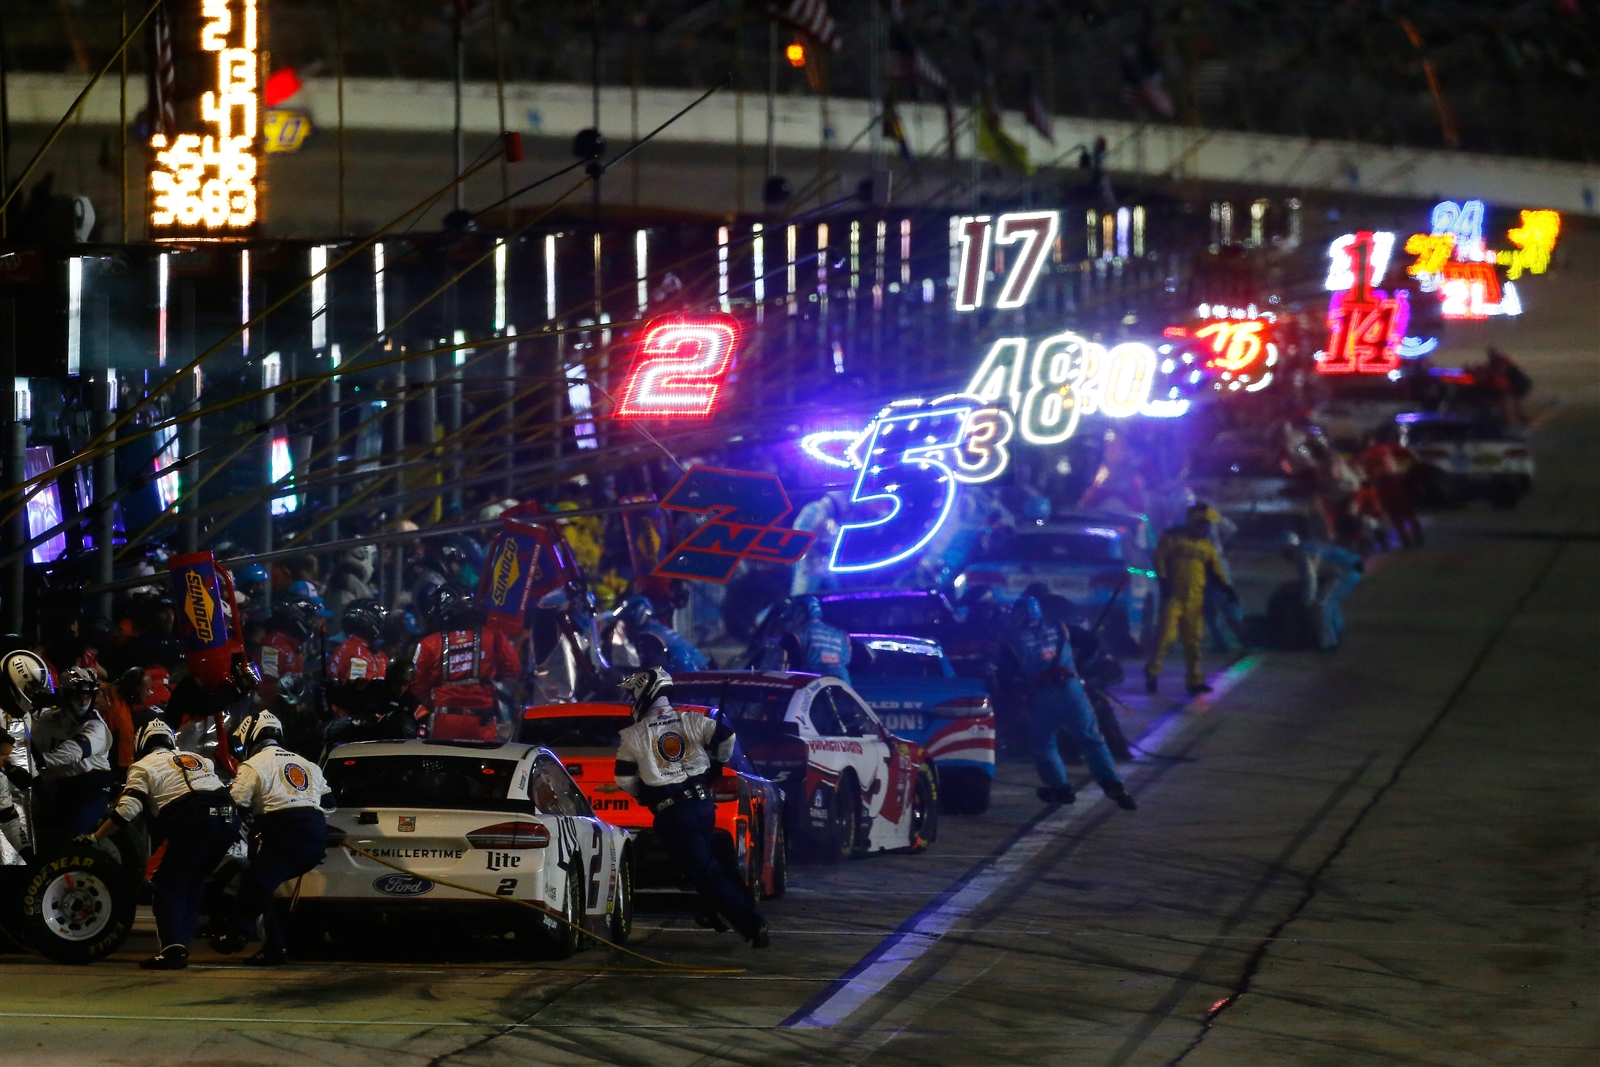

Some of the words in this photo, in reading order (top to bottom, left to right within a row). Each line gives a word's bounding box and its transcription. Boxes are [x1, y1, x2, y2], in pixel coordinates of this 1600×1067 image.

[954, 210, 1059, 312] 17
[613, 312, 742, 420] 2
[967, 335, 1088, 443] 48
[953, 407, 1013, 482] 3
[828, 406, 971, 571] 5
[185, 571, 214, 643] SUNOCO
[493, 538, 518, 604] SUNOCO
[24, 855, 95, 917] GOODYEAR
[384, 872, 423, 893] Ford
[485, 850, 521, 872] Lite
[496, 878, 518, 896] 2
